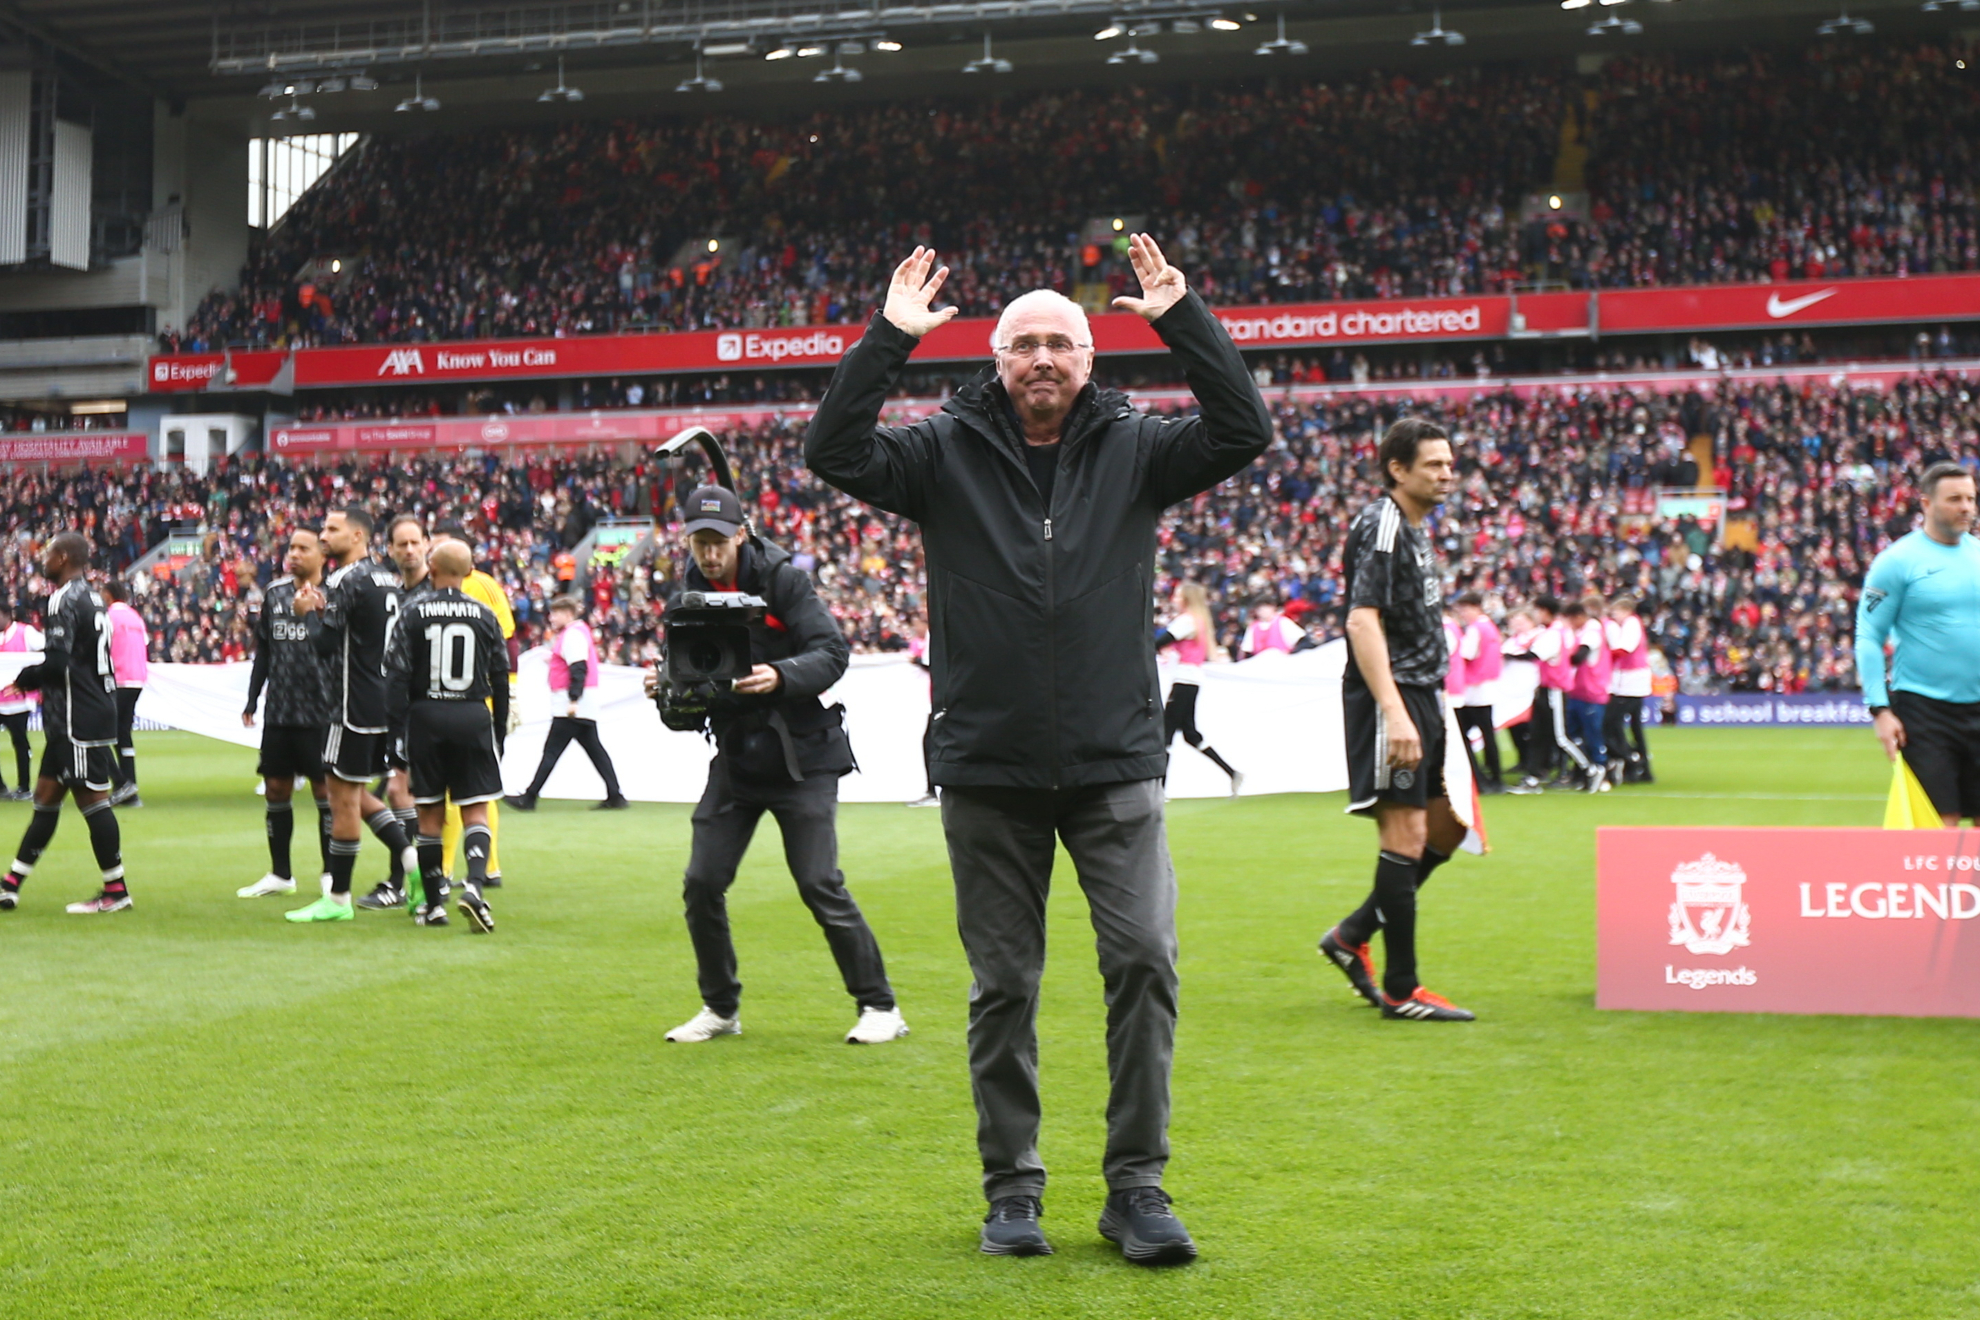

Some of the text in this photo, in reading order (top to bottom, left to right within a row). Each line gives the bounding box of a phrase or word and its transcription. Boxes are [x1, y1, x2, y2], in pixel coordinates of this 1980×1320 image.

[1221, 305, 1481, 340] tandard chartered
[745, 331, 843, 361] Expedia
[170, 361, 221, 381] Expedi
[378, 347, 557, 376] AXA Know You Can
[424, 622, 475, 691] 10
[1680, 705, 1695, 723] a
[1699, 701, 1772, 723] school
[1776, 701, 1874, 723] breakfas
[1904, 855, 1939, 871] LFC
[1665, 963, 1758, 990] Legends
